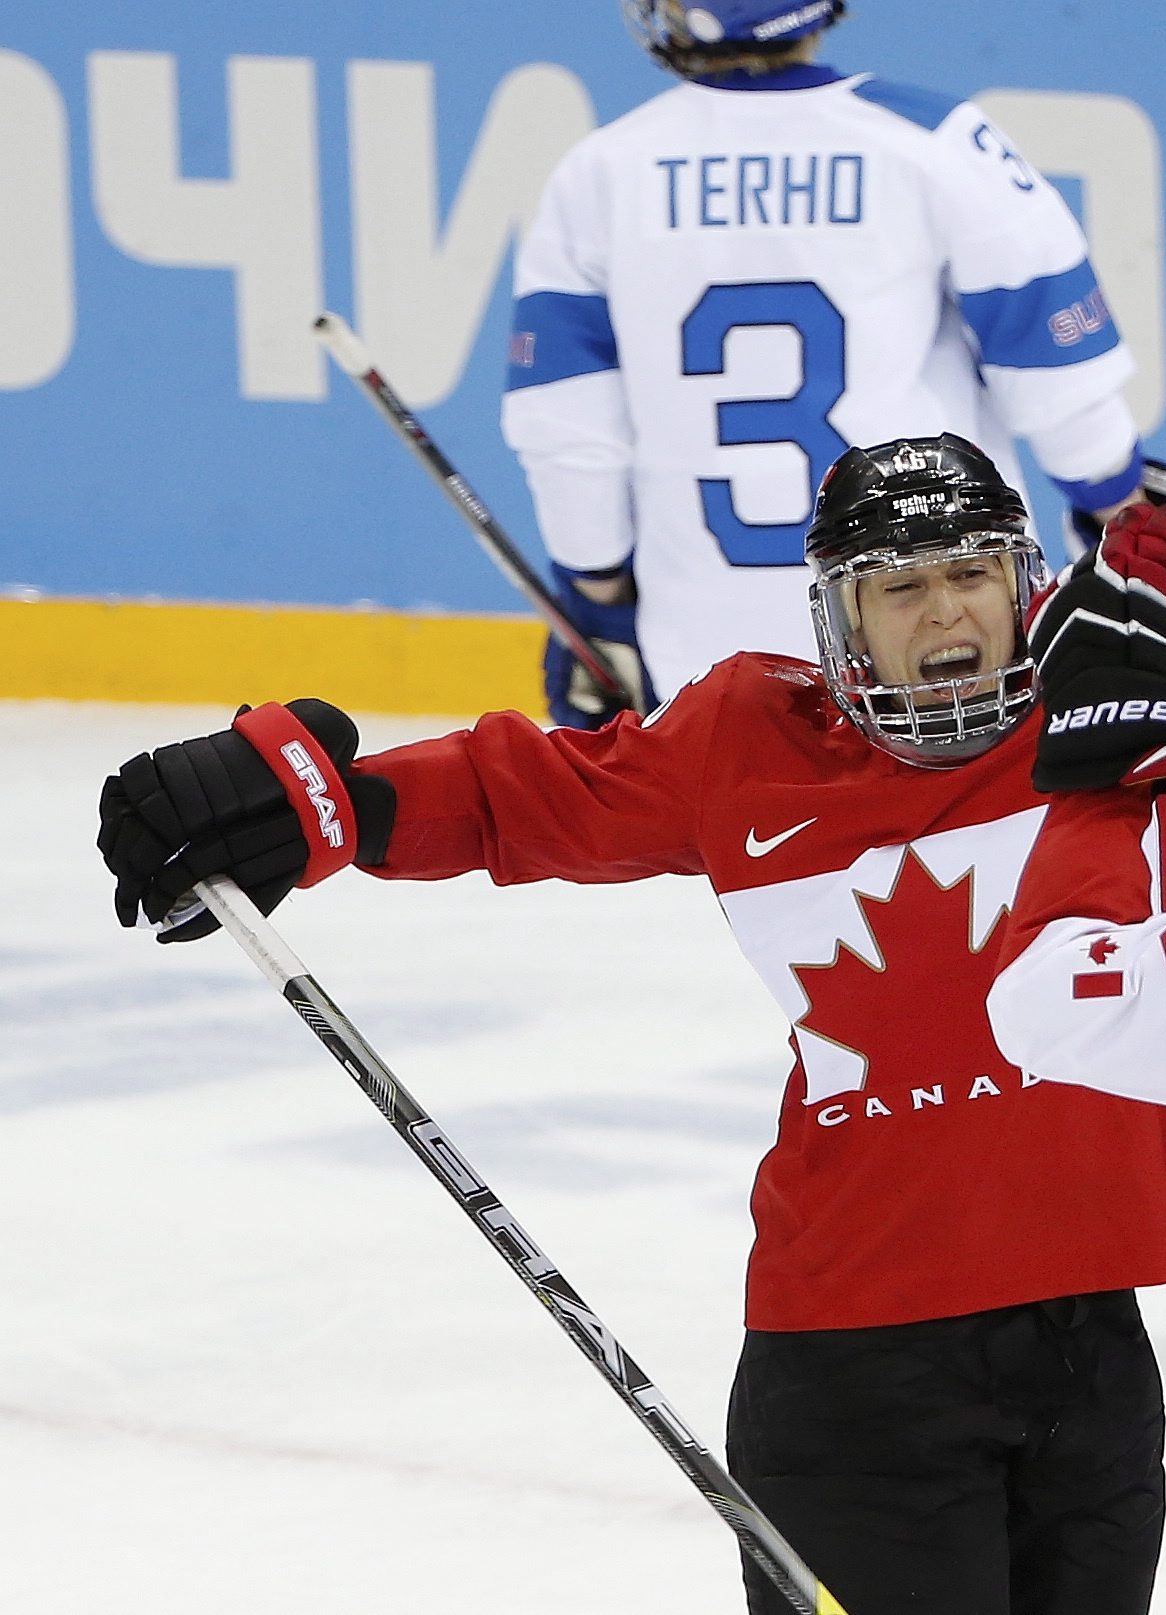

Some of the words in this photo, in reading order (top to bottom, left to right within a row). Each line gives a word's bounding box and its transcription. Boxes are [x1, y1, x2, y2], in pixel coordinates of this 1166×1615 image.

[655, 154, 863, 228] TERHO
[681, 280, 850, 568] 3
[280, 739, 345, 849] GRAF
[406, 1116, 710, 1456] GRAF
